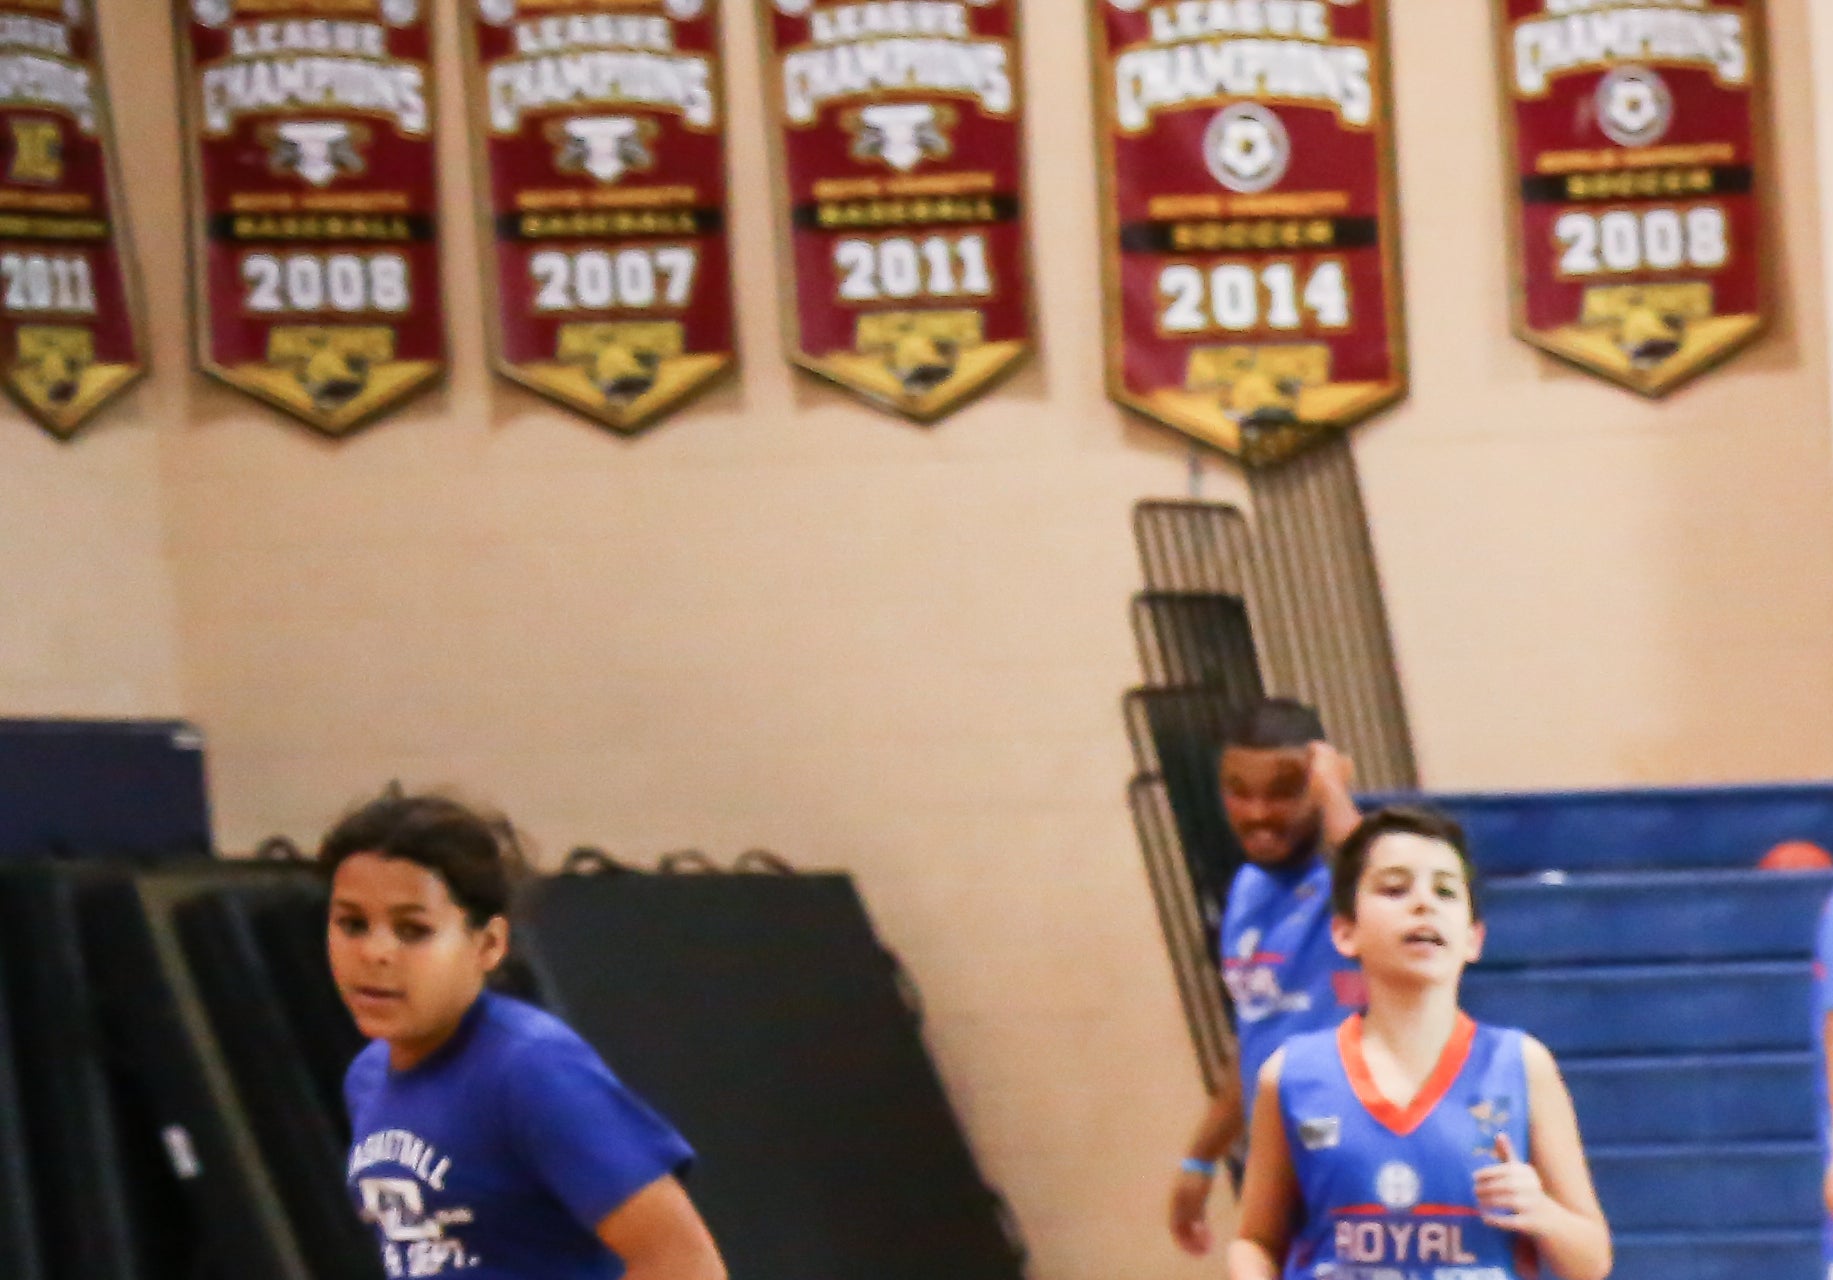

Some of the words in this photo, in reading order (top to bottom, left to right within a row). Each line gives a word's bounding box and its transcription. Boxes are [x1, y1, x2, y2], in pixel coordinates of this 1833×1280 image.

[833, 234, 992, 299] 2011
[1554, 206, 1729, 275] 2008
[241, 254, 410, 313] 2008
[529, 246, 697, 311] 2007
[1158, 260, 1351, 332] 2014
